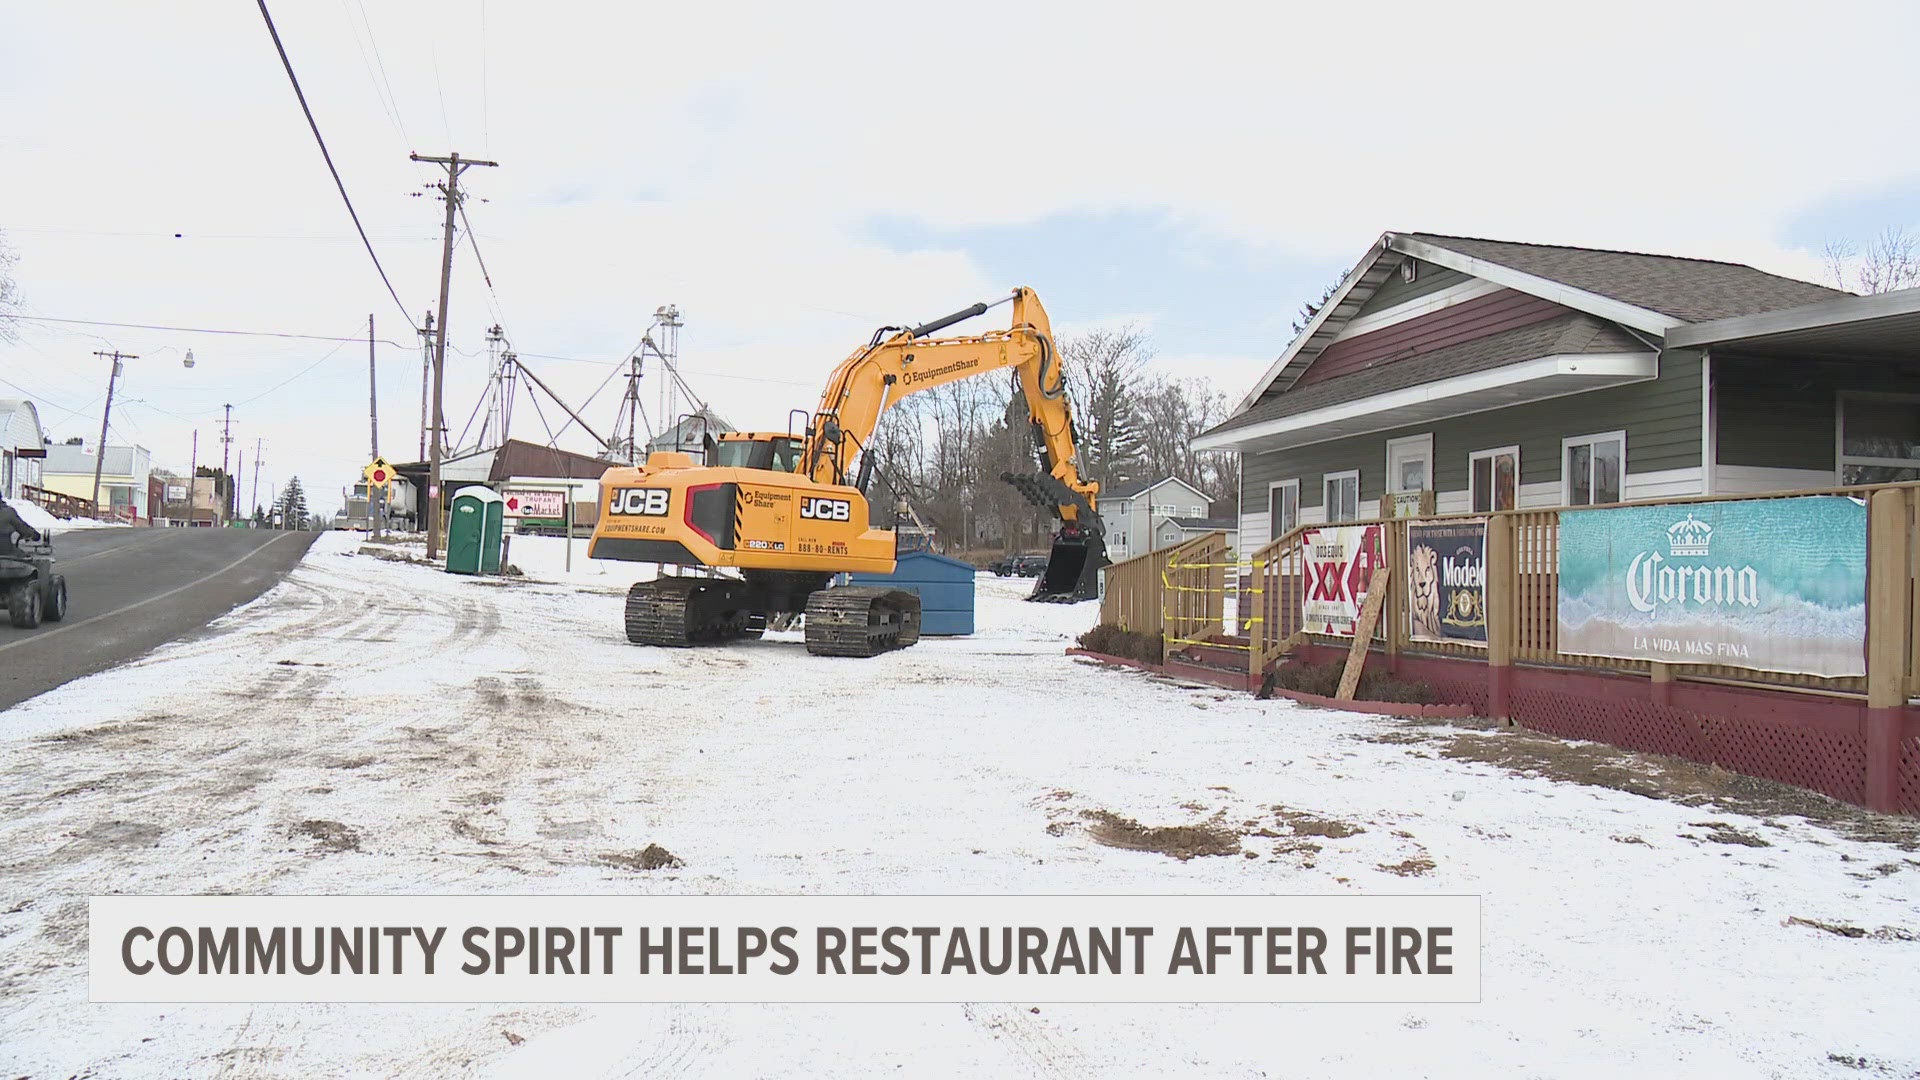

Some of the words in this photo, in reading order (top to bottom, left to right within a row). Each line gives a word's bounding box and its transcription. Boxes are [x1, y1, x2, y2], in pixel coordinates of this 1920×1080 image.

[912, 358, 979, 383] EquipmentShare
[610, 488, 669, 515] JCB
[753, 499, 775, 508] Share
[754, 491, 792, 502] Equipment
[1396, 495, 1419, 504] CAUTION
[534, 503, 561, 516] Market
[801, 498, 850, 521] JCB
[604, 524, 666, 535] EQUIPMENTSHARE.COM
[798, 543, 849, 555] 888-80-RENTS
[1312, 561, 1348, 602] XX
[1626, 550, 1761, 620] Corona
[1633, 636, 1648, 651] LA
[1652, 638, 1681, 653] VIDA
[1717, 642, 1749, 659] FINA
